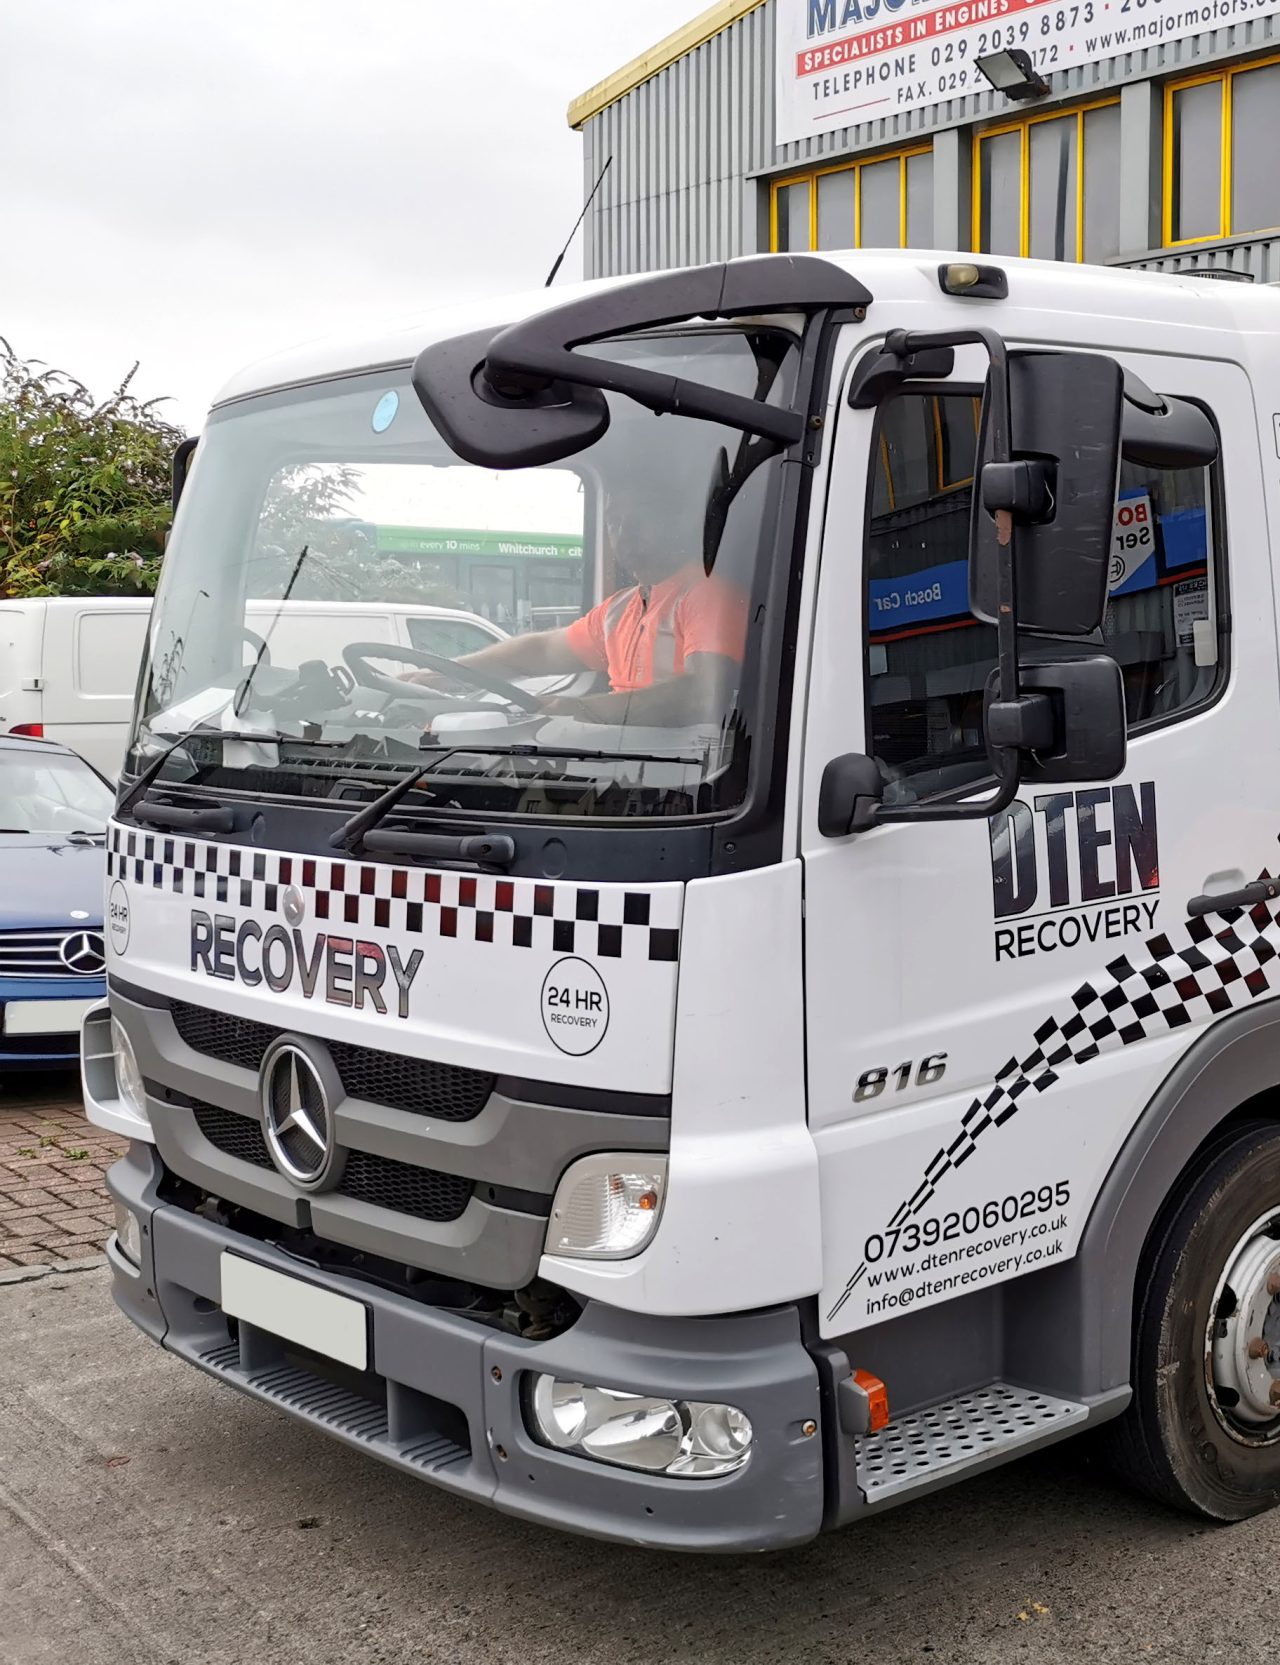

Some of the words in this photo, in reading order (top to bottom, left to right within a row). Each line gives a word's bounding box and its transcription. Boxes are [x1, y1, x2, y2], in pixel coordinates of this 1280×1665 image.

[804, 26, 903, 71] SPECIALISTS
[910, 19, 927, 40] IN
[935, 0, 1009, 36] ENGINES
[813, 53, 916, 100] TELEPHONE
[931, 39, 968, 67] 029
[978, 21, 1029, 54] 2039
[1040, 2, 1094, 36] 8873
[897, 81, 932, 104] FAX.
[938, 70, 967, 92] 029
[1031, 44, 1058, 67] 172
[1086, 0, 1277, 53] www.majormotors.
[446, 540, 457, 550] 10
[459, 542, 480, 552] mins
[499, 542, 558, 556] Whitchurch
[568, 546, 583, 557] cit
[988, 781, 1160, 918] DTEN
[190, 909, 425, 1019] RECOVERY
[995, 899, 1160, 962] RECOVERY
[548, 986, 571, 1008] 24
[575, 989, 602, 1012] HR
[550, 1012, 598, 1029] RECOVERY
[853, 1052, 948, 1103] 816
[864, 1180, 1070, 1263] 07392060295
[867, 1214, 1068, 1288] www.dtenrecovery.co.uk
[866, 1239, 1063, 1315] info@dtenrecovery.co.uk
